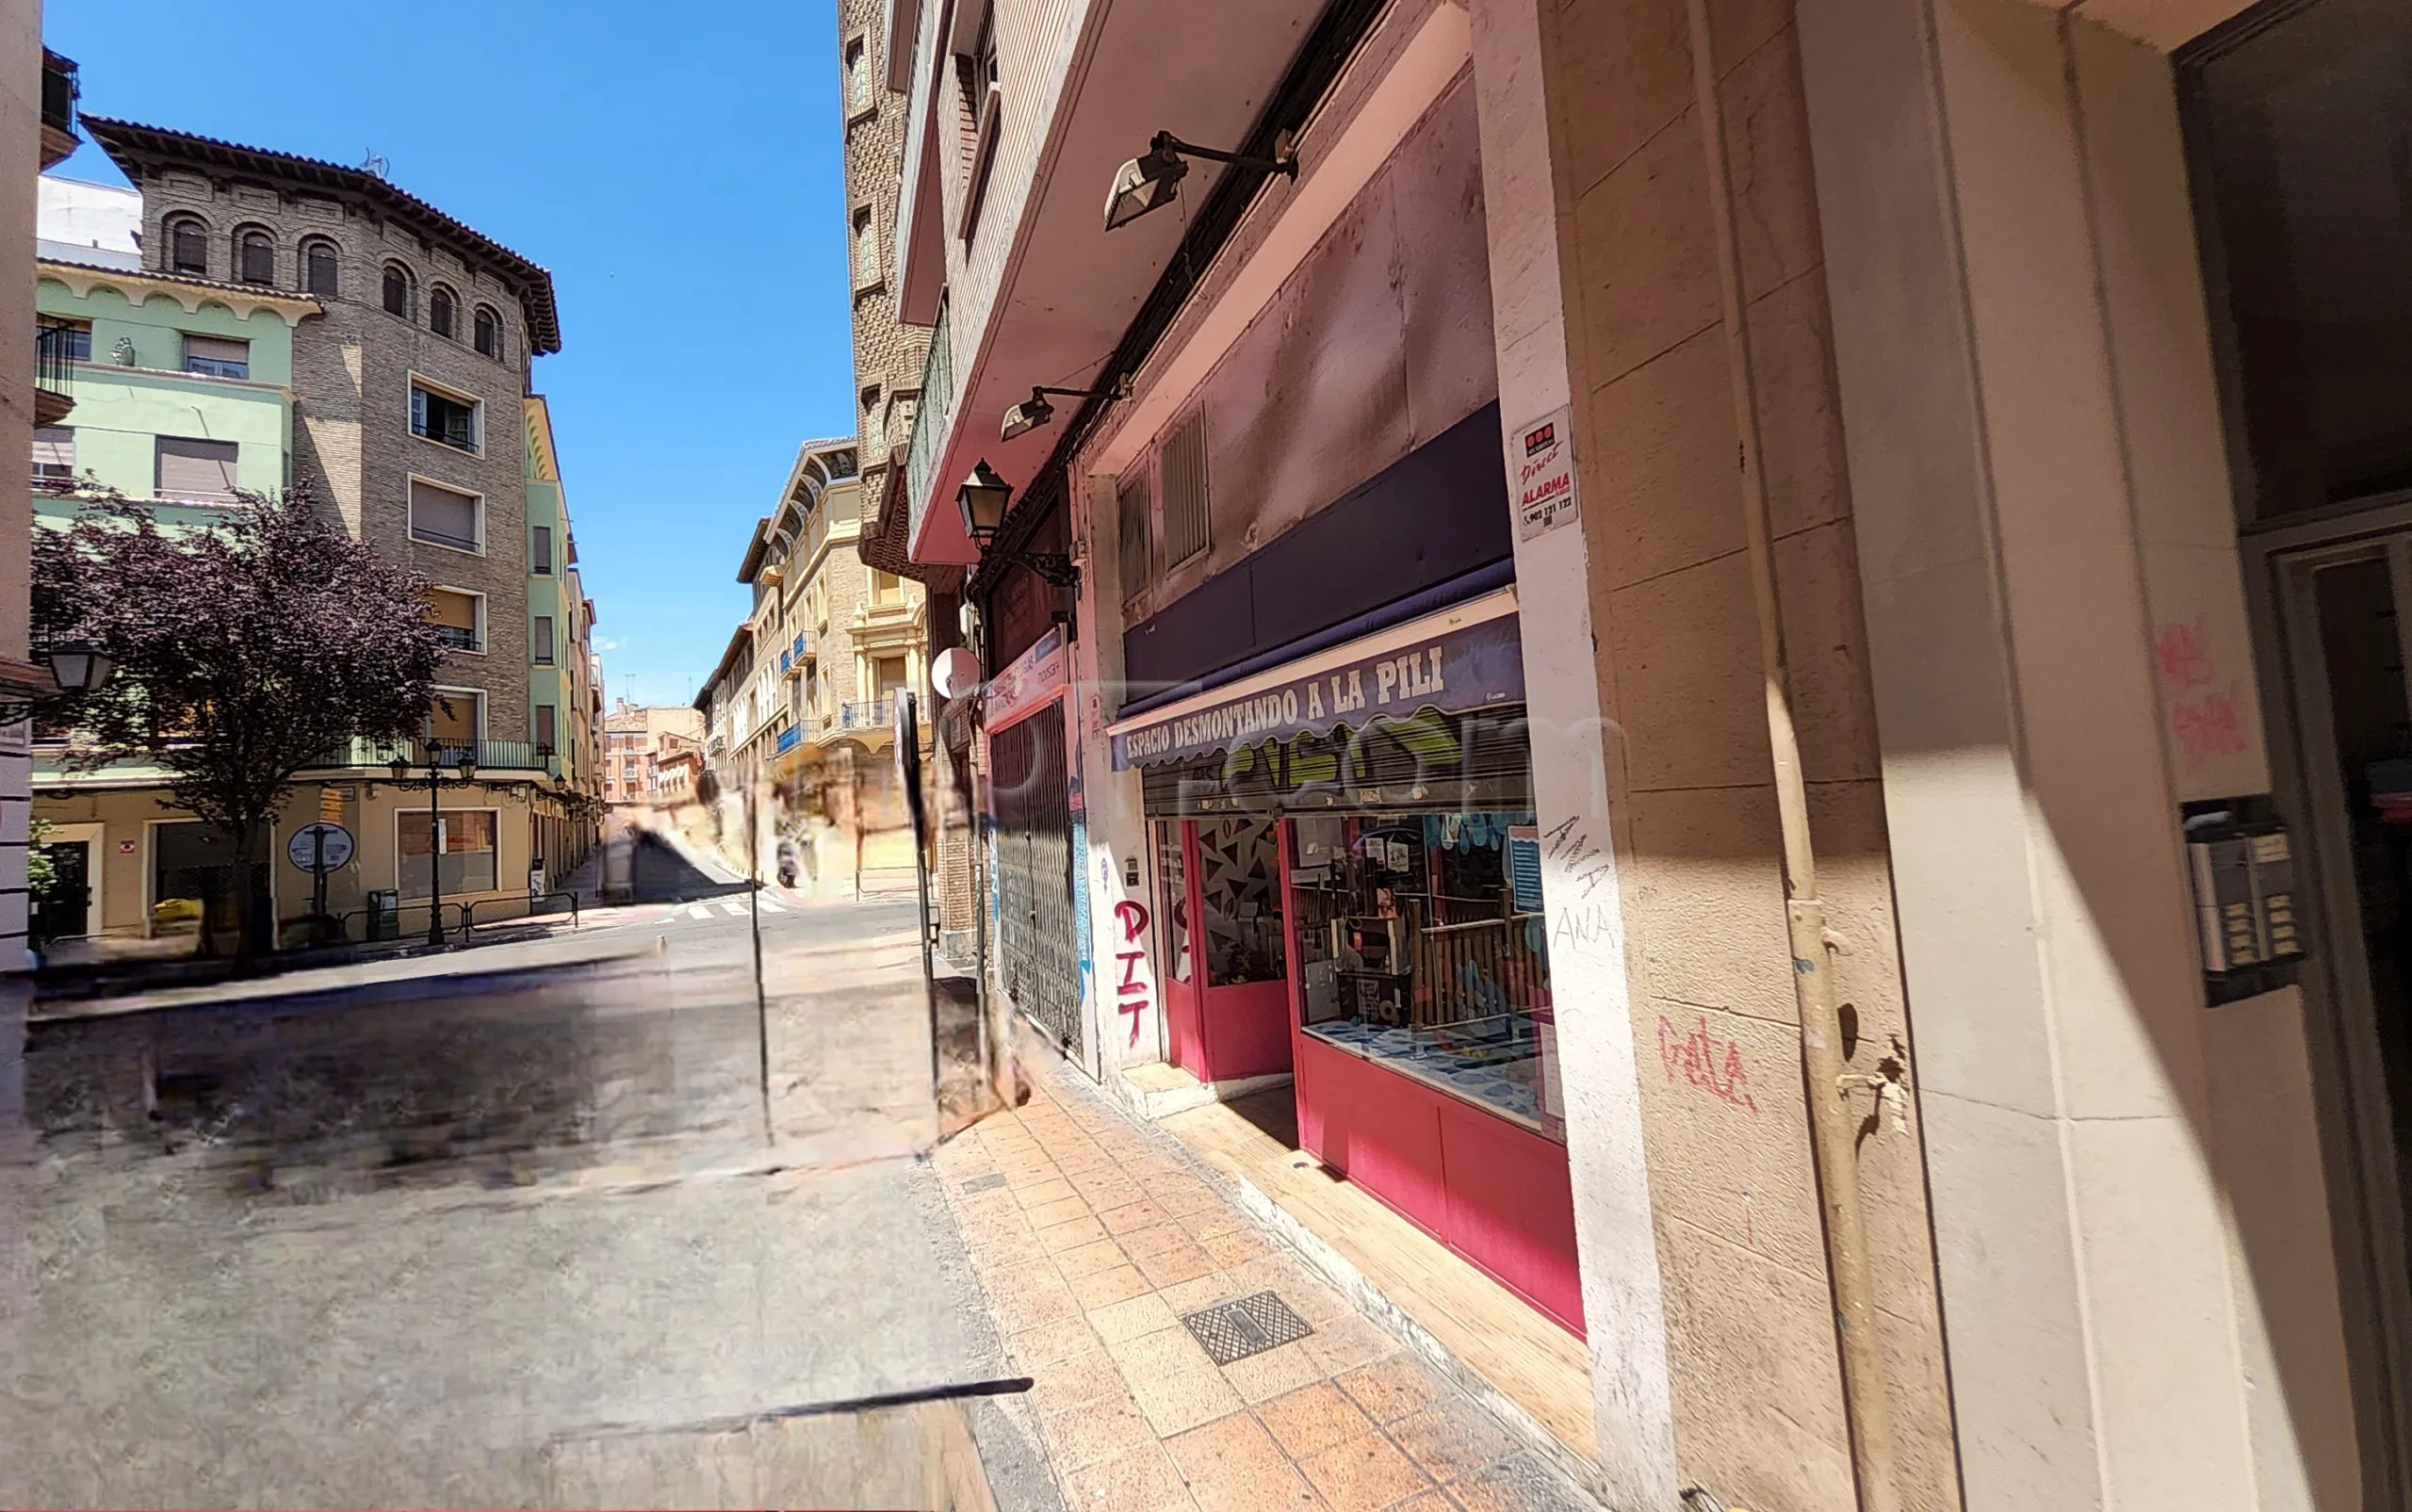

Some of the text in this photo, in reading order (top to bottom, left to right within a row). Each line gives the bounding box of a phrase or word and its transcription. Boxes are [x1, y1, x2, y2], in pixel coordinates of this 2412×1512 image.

[1520, 440, 1564, 485] Direct
[1522, 472, 1571, 507] ALARMA
[1528, 496, 1573, 523] 902 121 122
[1126, 724, 1170, 759] ESPACIO
[1174, 689, 1298, 749] DESMONTANDO
[1308, 681, 1325, 721] A
[1330, 669, 1365, 715] LA
[1376, 645, 1444, 706] PILI
[1553, 903, 1615, 951] ANA
